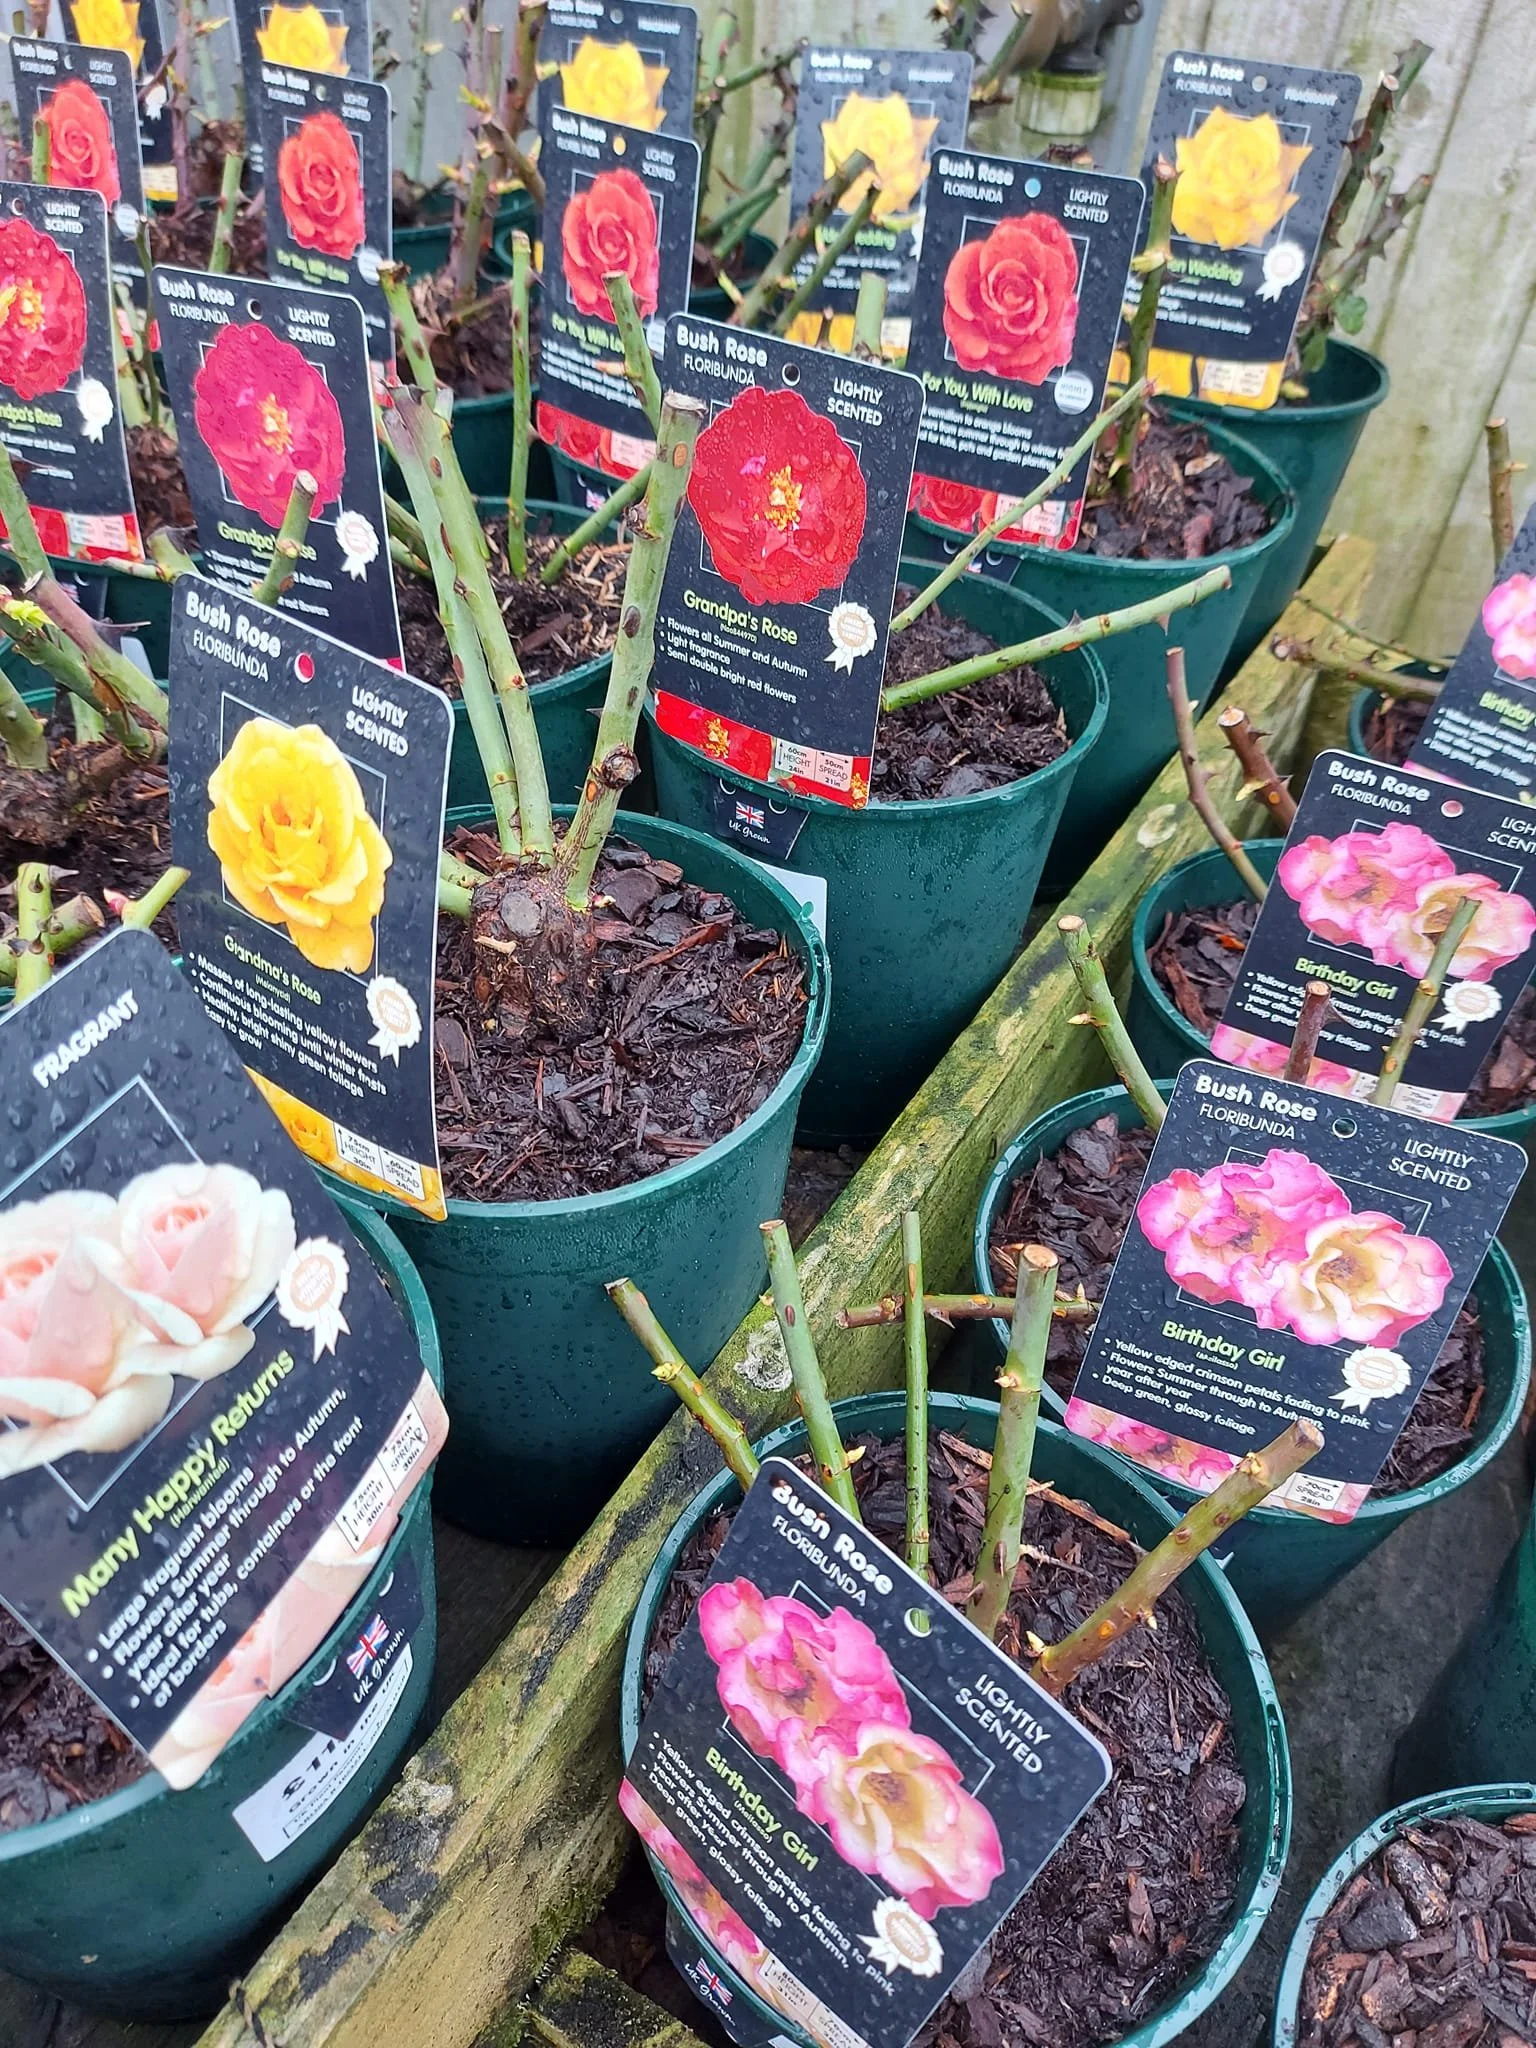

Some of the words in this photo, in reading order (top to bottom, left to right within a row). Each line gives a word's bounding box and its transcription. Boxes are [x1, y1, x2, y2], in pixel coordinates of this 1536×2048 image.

[1173, 57, 1208, 77] Bush
[1210, 62, 1245, 82] Rose
[642, 161, 676, 182] SCENTED
[645, 147, 675, 166] LIGHTLY
[939, 156, 974, 180] Bush
[978, 161, 1014, 187] Rose
[46, 203, 80, 219] LIGHTLY
[943, 181, 1004, 204] FLORIBUNDA
[1063, 204, 1109, 224] SCENTED
[1069, 188, 1109, 206] LIGHTLY
[45, 218, 84, 234] SCENTED
[159, 276, 196, 300] Bush
[198, 281, 235, 306] Rose
[1189, 258, 1243, 286] Wedding
[170, 303, 231, 325] FLORIBUNDA
[288, 307, 331, 326] LIGHTLY
[287, 324, 336, 348] SCENTED
[676, 324, 719, 354] Bush
[725, 336, 768, 368] Rose
[684, 353, 756, 387] FLORIBUNDA
[833, 376, 883, 405] LIGHTLY
[827, 397, 883, 428] SCENTED
[922, 371, 942, 392] For
[944, 376, 969, 401] You,
[972, 381, 1002, 406] With
[1002, 390, 1034, 413] Love
[186, 591, 231, 635] Bush
[235, 614, 282, 658] Rose
[683, 589, 759, 631] Grandpa's
[762, 617, 798, 645] Rose
[193, 628, 269, 683] FLORIBUNDA
[667, 617, 699, 638] Flowers
[701, 630, 712, 643] all
[713, 634, 751, 657] Summer
[752, 650, 770, 664] and
[771, 656, 808, 678] Autumn
[667, 631, 687, 648] Light
[689, 638, 731, 665] fragrance
[667, 646, 688, 663] Semi
[689, 653, 719, 675] double
[719, 665, 746, 686] bright
[747, 678, 762, 692] red
[764, 684, 797, 704] flowers
[352, 685, 408, 728] LIGHTLY
[1479, 691, 1536, 726] Birthday
[345, 710, 408, 757] SCENTED
[788, 747, 807, 758] 60cm
[783, 753, 811, 767] HEIGHT
[819, 765, 848, 781] SPREAD
[1327, 760, 1378, 787] Bush
[1381, 775, 1431, 802] Rose
[1330, 783, 1413, 816] FLORIBUNDA
[224, 934, 289, 987] Grandma's
[291, 972, 322, 1005] Rose
[1295, 957, 1365, 991] Birthday
[1365, 980, 1398, 1000] Girl
[198, 954, 233, 985] Masses
[246, 982, 303, 1031] long-lasting
[304, 1021, 338, 1050] yellow
[339, 1040, 378, 1074] flowers
[1252, 983, 1289, 1003] Flowers
[32, 988, 140, 1090] FRAGRANT
[200, 971, 252, 1013] Continuous
[253, 1003, 299, 1044] blooming
[300, 1035, 322, 1057] until
[323, 1050, 356, 1077] winter
[201, 988, 240, 1022] Healthy,
[241, 1012, 269, 1039] bright
[270, 1033, 296, 1058] shiny
[298, 1050, 327, 1076] green
[328, 1066, 364, 1098] foliage
[238, 1028, 262, 1050] grow
[1335, 1034, 1372, 1052] foliage
[1195, 1074, 1254, 1106] Bush
[1260, 1090, 1318, 1122] Rose
[1199, 1103, 1297, 1141] FLORIBUNDA
[1388, 1157, 1472, 1192] SCENTED
[1404, 1138, 1474, 1170] LIGHTLY
[1162, 1320, 1246, 1361] Birthday
[1248, 1349, 1286, 1373] Girl
[1105, 1364, 1134, 1380] year
[1134, 1373, 1164, 1390] after
[1164, 1384, 1193, 1400] year
[1110, 1352, 1155, 1375] Flowers
[1156, 1367, 1208, 1393] Summer
[1208, 1385, 1257, 1409] through
[1115, 1339, 1153, 1360] Yellow
[1154, 1354, 1195, 1374] edged
[1195, 1367, 1244, 1389] crimson
[1243, 1383, 1283, 1402] petals
[1284, 1394, 1325, 1417] fading
[1326, 1407, 1340, 1421] to
[1340, 1414, 1371, 1431] pink
[1102, 1375, 1134, 1394] Deep
[1134, 1389, 1172, 1409] green,
[1174, 1401, 1212, 1422] glossy
[1214, 1414, 1257, 1436] foliage
[60, 1526, 140, 1619] Many
[133, 1438, 217, 1534] Happy
[211, 1349, 295, 1446] Returns
[1296, 1485, 1334, 1502] SPREAD
[113, 1595, 175, 1666] Flowers
[171, 1525, 231, 1599] Summer
[228, 1464, 283, 1528] through
[278, 1446, 297, 1468] to
[295, 1388, 347, 1451] Autumn,
[98, 1594, 147, 1650] Large
[142, 1521, 205, 1598] fragrant
[200, 1466, 255, 1529] blooms
[140, 1643, 182, 1696] Ideal
[177, 1619, 202, 1649] for
[200, 1582, 239, 1623] tubs,
[236, 1497, 302, 1580] containers
[300, 1478, 315, 1500] or
[313, 1453, 337, 1482] the
[333, 1415, 364, 1456] front
[771, 1515, 868, 1607] FLORIBUNDA
[833, 1533, 895, 1596] Rose
[128, 1634, 164, 1682] year
[164, 1591, 199, 1637] after
[198, 1553, 231, 1598] year
[154, 1680, 173, 1708] of
[168, 1619, 227, 1688] borders
[353, 1675, 373, 1704] UK
[974, 1674, 1051, 1744] LIGHTLY
[955, 1687, 1043, 1774] SCENTED
[289, 1761, 338, 1813] Grown
[344, 1739, 355, 1754] in
[360, 1703, 378, 1730] the
[653, 1762, 677, 1789] year
[677, 1791, 702, 1819] after
[702, 1819, 727, 1848] year
[705, 1746, 782, 1833] Birthday
[783, 1831, 819, 1872] Girl
[649, 1772, 676, 1806] Deep
[676, 1807, 708, 1846] green,
[708, 1846, 744, 1885] glossy
[743, 1883, 783, 1929] foliage
[657, 1751, 696, 1798] Flowers
[696, 1796, 742, 1848] Summer
[741, 1848, 786, 1899] through
[800, 1912, 849, 1969] Autumn,
[663, 1739, 695, 1779] Yellow
[695, 1780, 732, 1819] edged
[731, 1819, 775, 1868] crimson
[774, 1867, 813, 1908] petals
[811, 1905, 851, 1951] fading
[865, 1964, 895, 1997] pink
